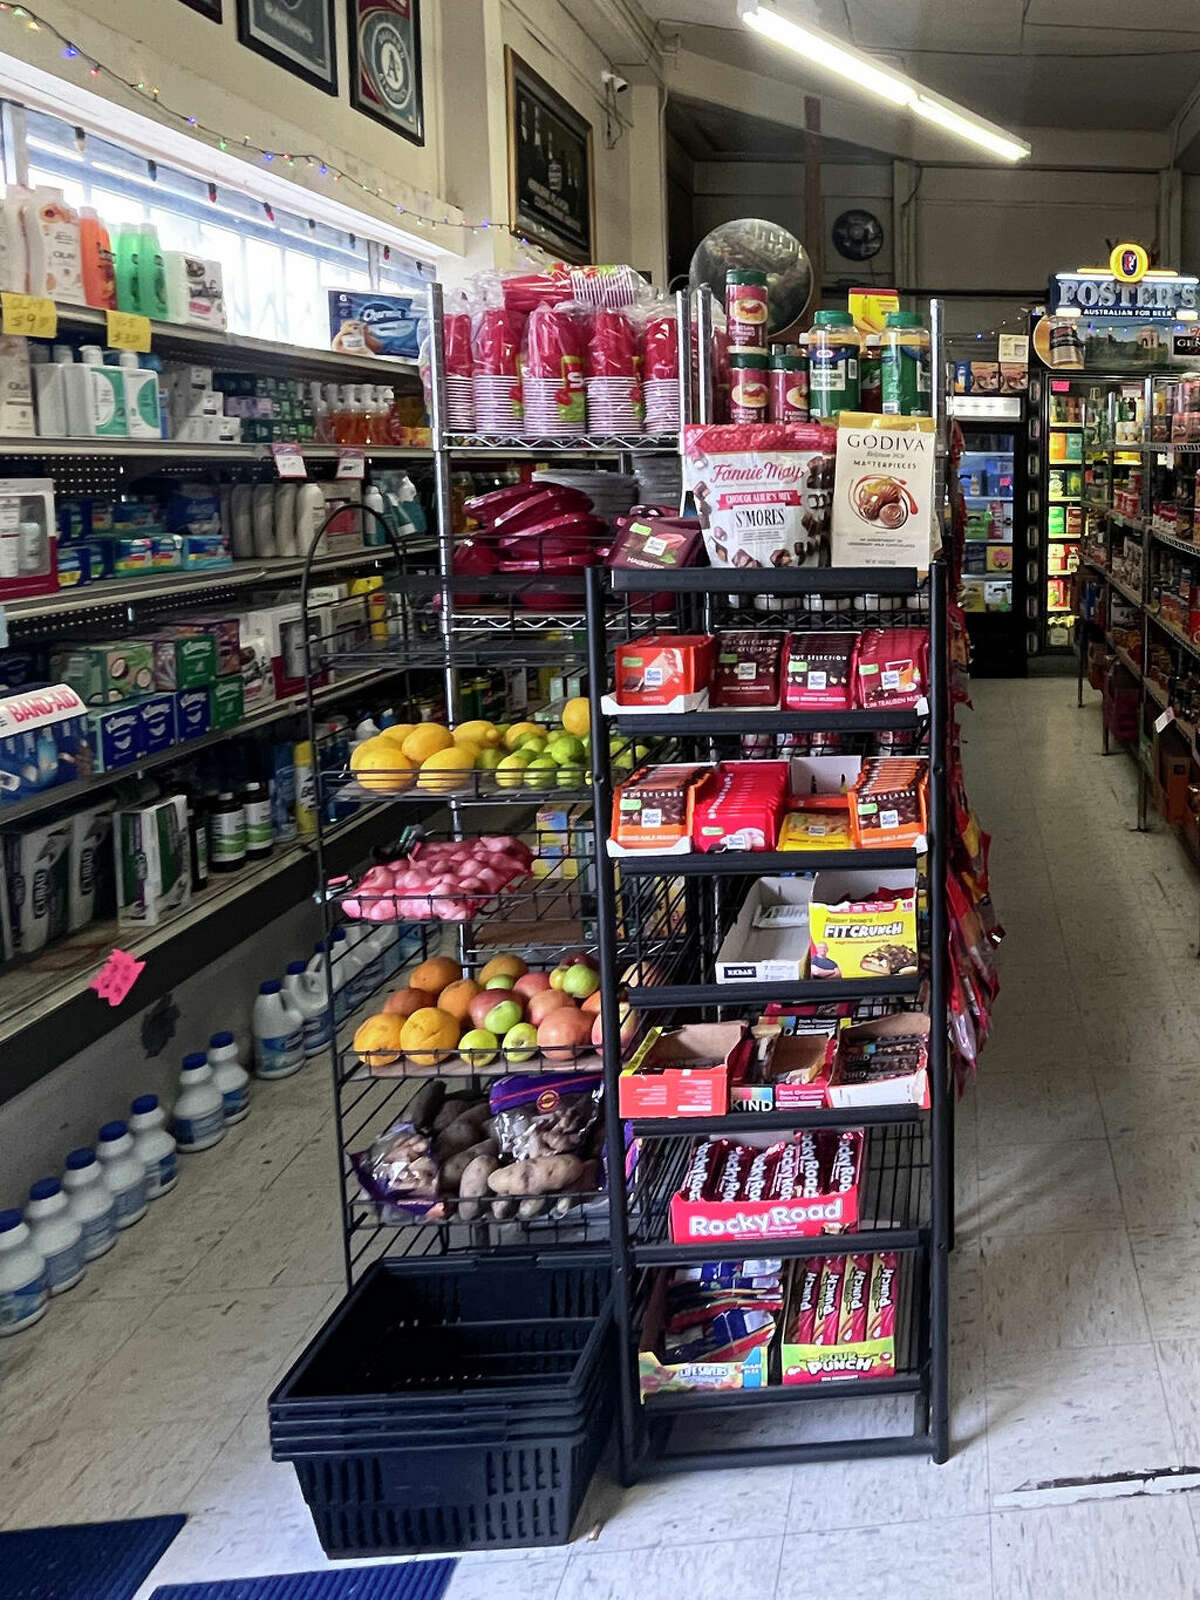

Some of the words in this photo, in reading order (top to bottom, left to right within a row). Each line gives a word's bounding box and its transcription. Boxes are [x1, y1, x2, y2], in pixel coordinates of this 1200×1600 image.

[1058, 280, 1198, 309] FOSTER'S
[1084, 308, 1133, 317] AUSTRALIAN
[1134, 309, 1151, 317] FOR
[847, 433, 925, 451] GODIVA
[710, 463, 763, 484] Fannie
[763, 461, 807, 483] May
[853, 460, 917, 469] MASTERPIECES
[735, 508, 786, 528] S'MORES
[789, 653, 804, 661] NUT
[806, 654, 848, 662] SELECTION
[8, 690, 79, 723] BAND-AID
[824, 922, 904, 938] FITCRUNCH
[731, 1100, 774, 1112] KIND
[689, 1211, 769, 1238] Rocky
[770, 1198, 844, 1225] Road
[807, 1359, 874, 1375] PUNCH
